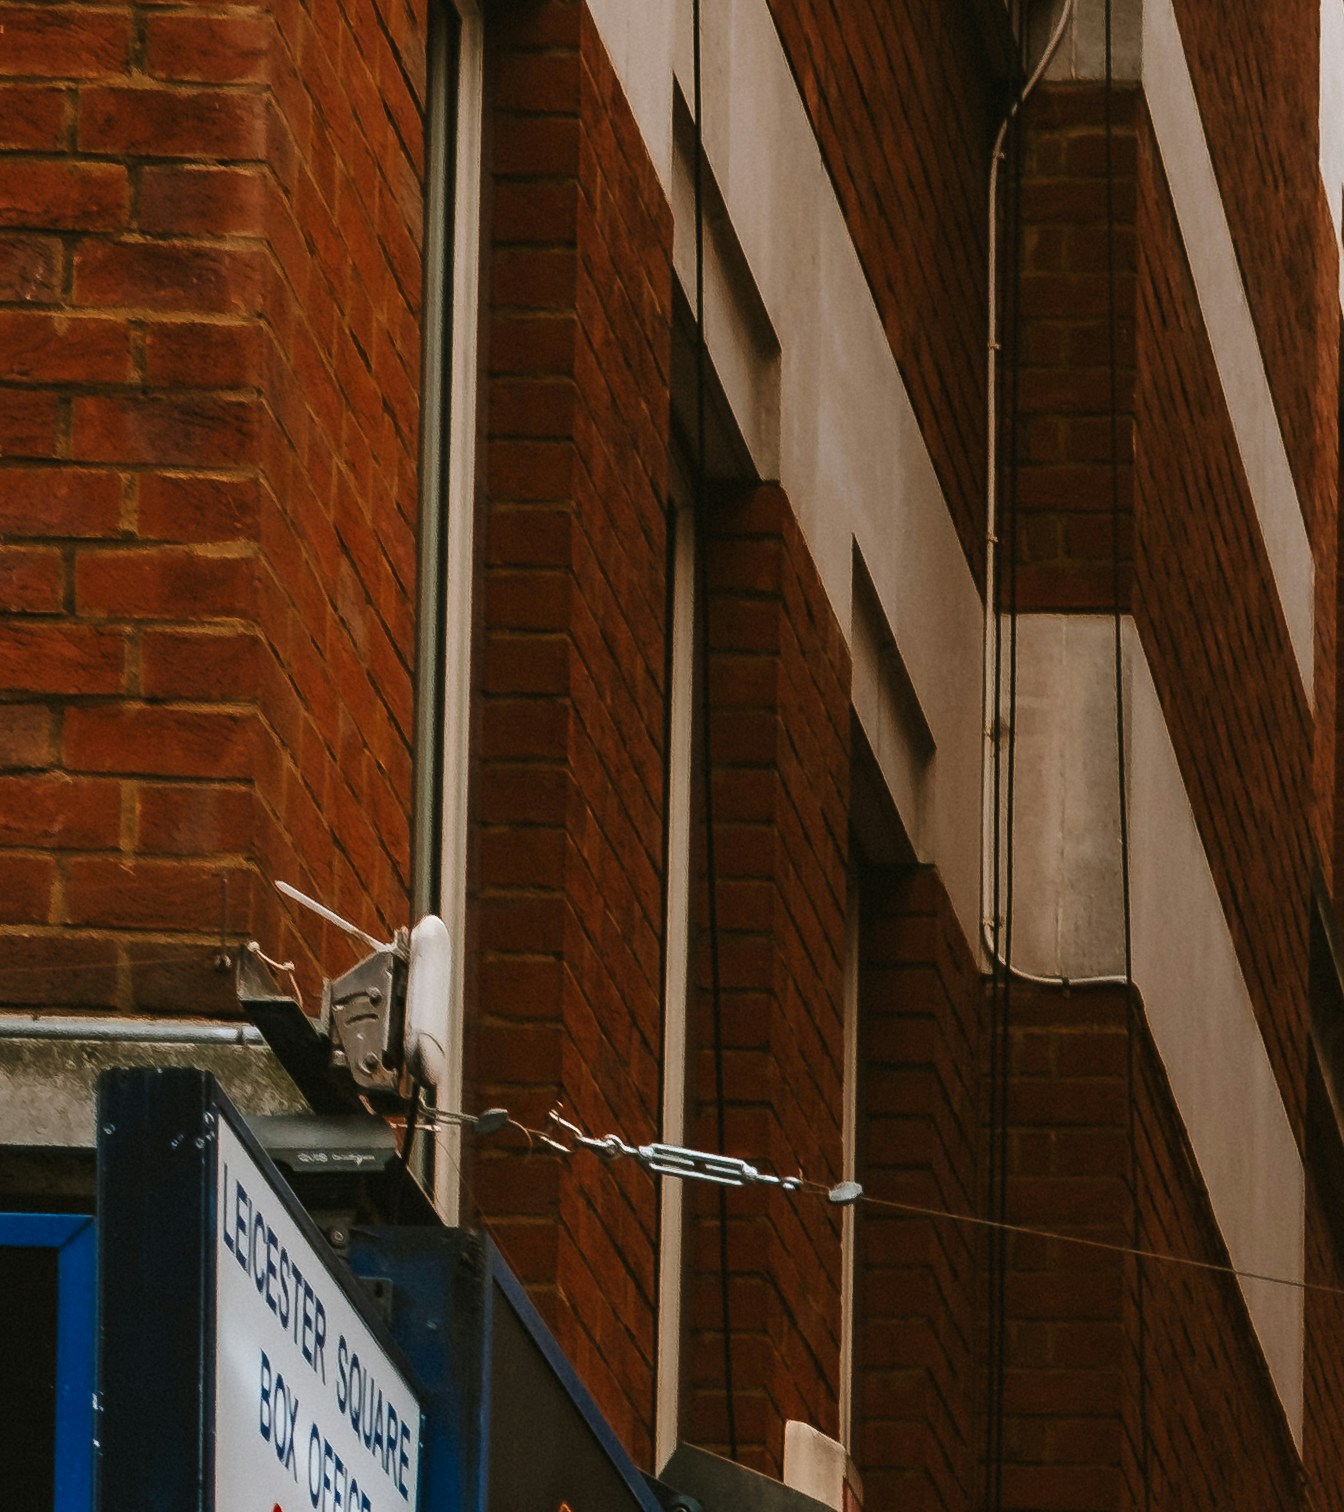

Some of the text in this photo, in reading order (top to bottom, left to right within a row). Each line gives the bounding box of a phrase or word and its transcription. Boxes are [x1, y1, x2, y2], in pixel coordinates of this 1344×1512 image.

[222, 1161, 411, 1503] LEICESTER SQUARE
[258, 1348, 300, 1492] BOX
